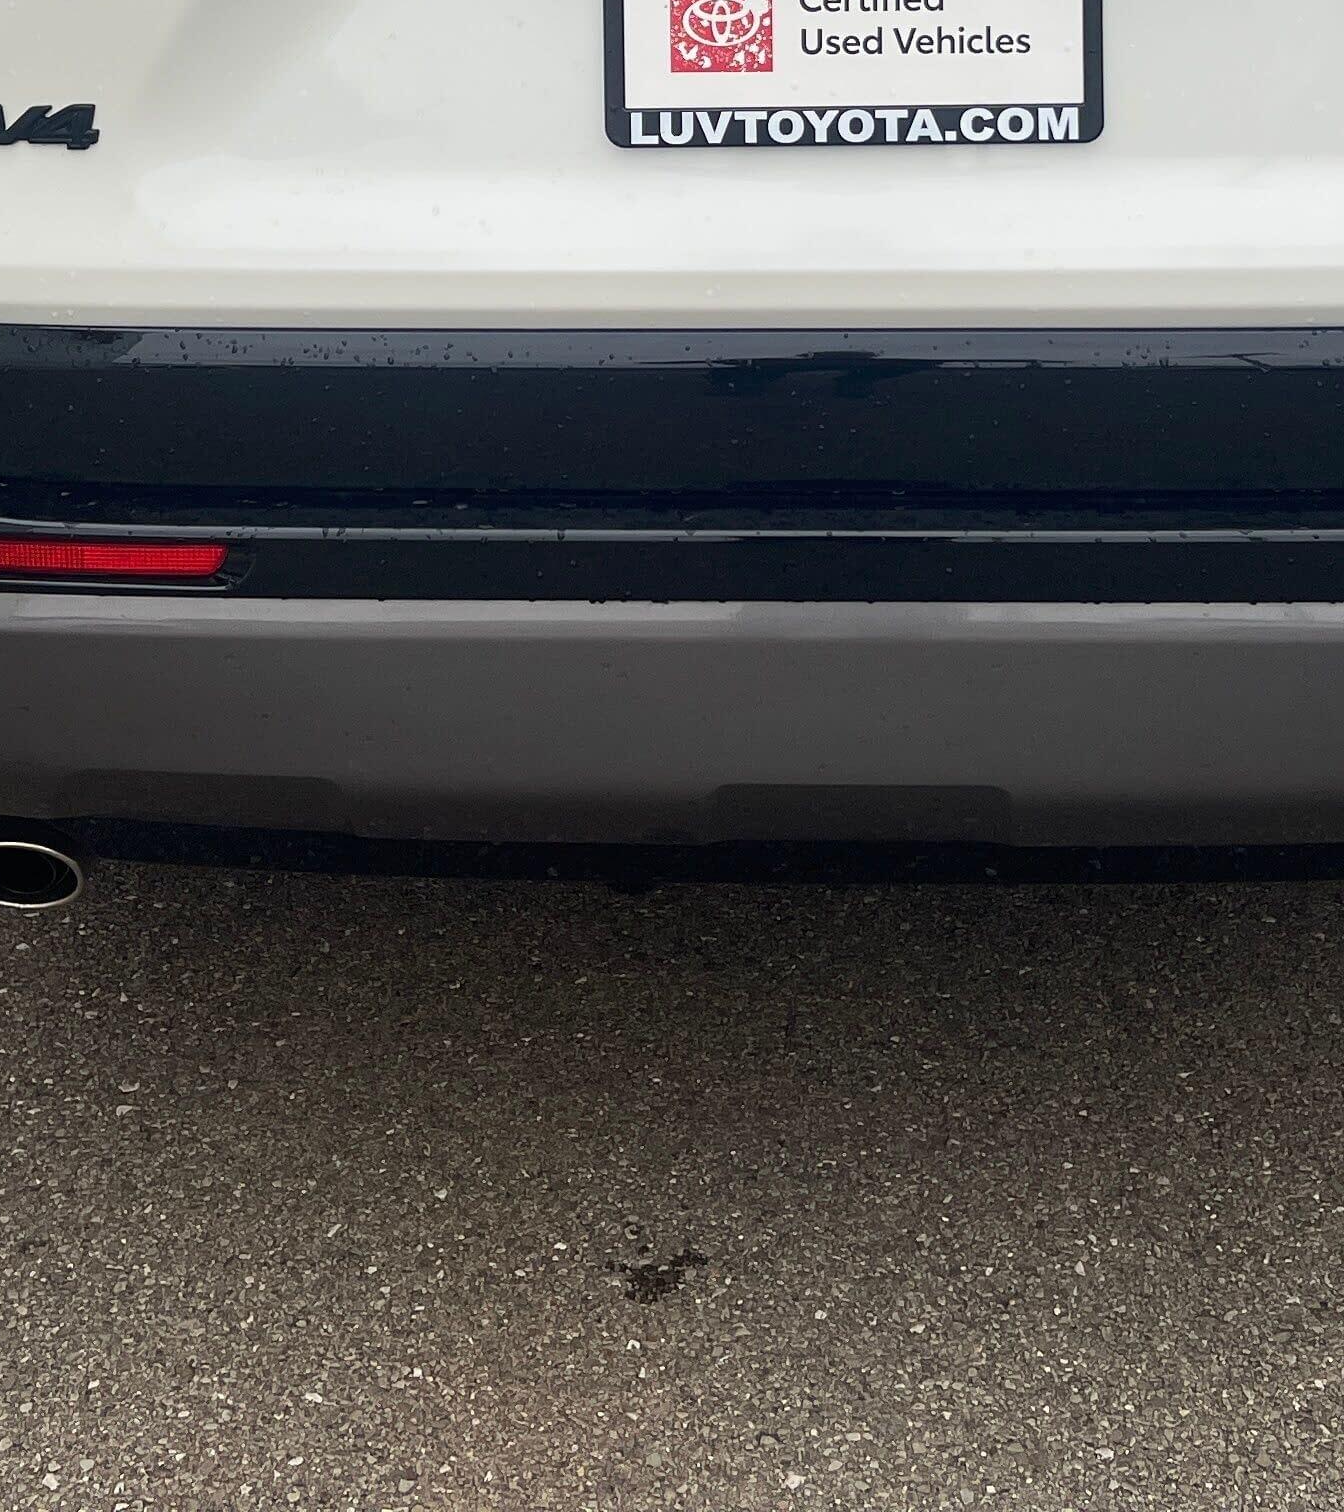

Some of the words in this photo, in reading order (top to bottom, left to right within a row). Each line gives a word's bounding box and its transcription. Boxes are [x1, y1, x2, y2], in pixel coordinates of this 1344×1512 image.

[800, 28, 884, 56] Used
[899, 25, 1031, 55] Vehicles
[630, 107, 1080, 146] LUVTOYOTA.COM
